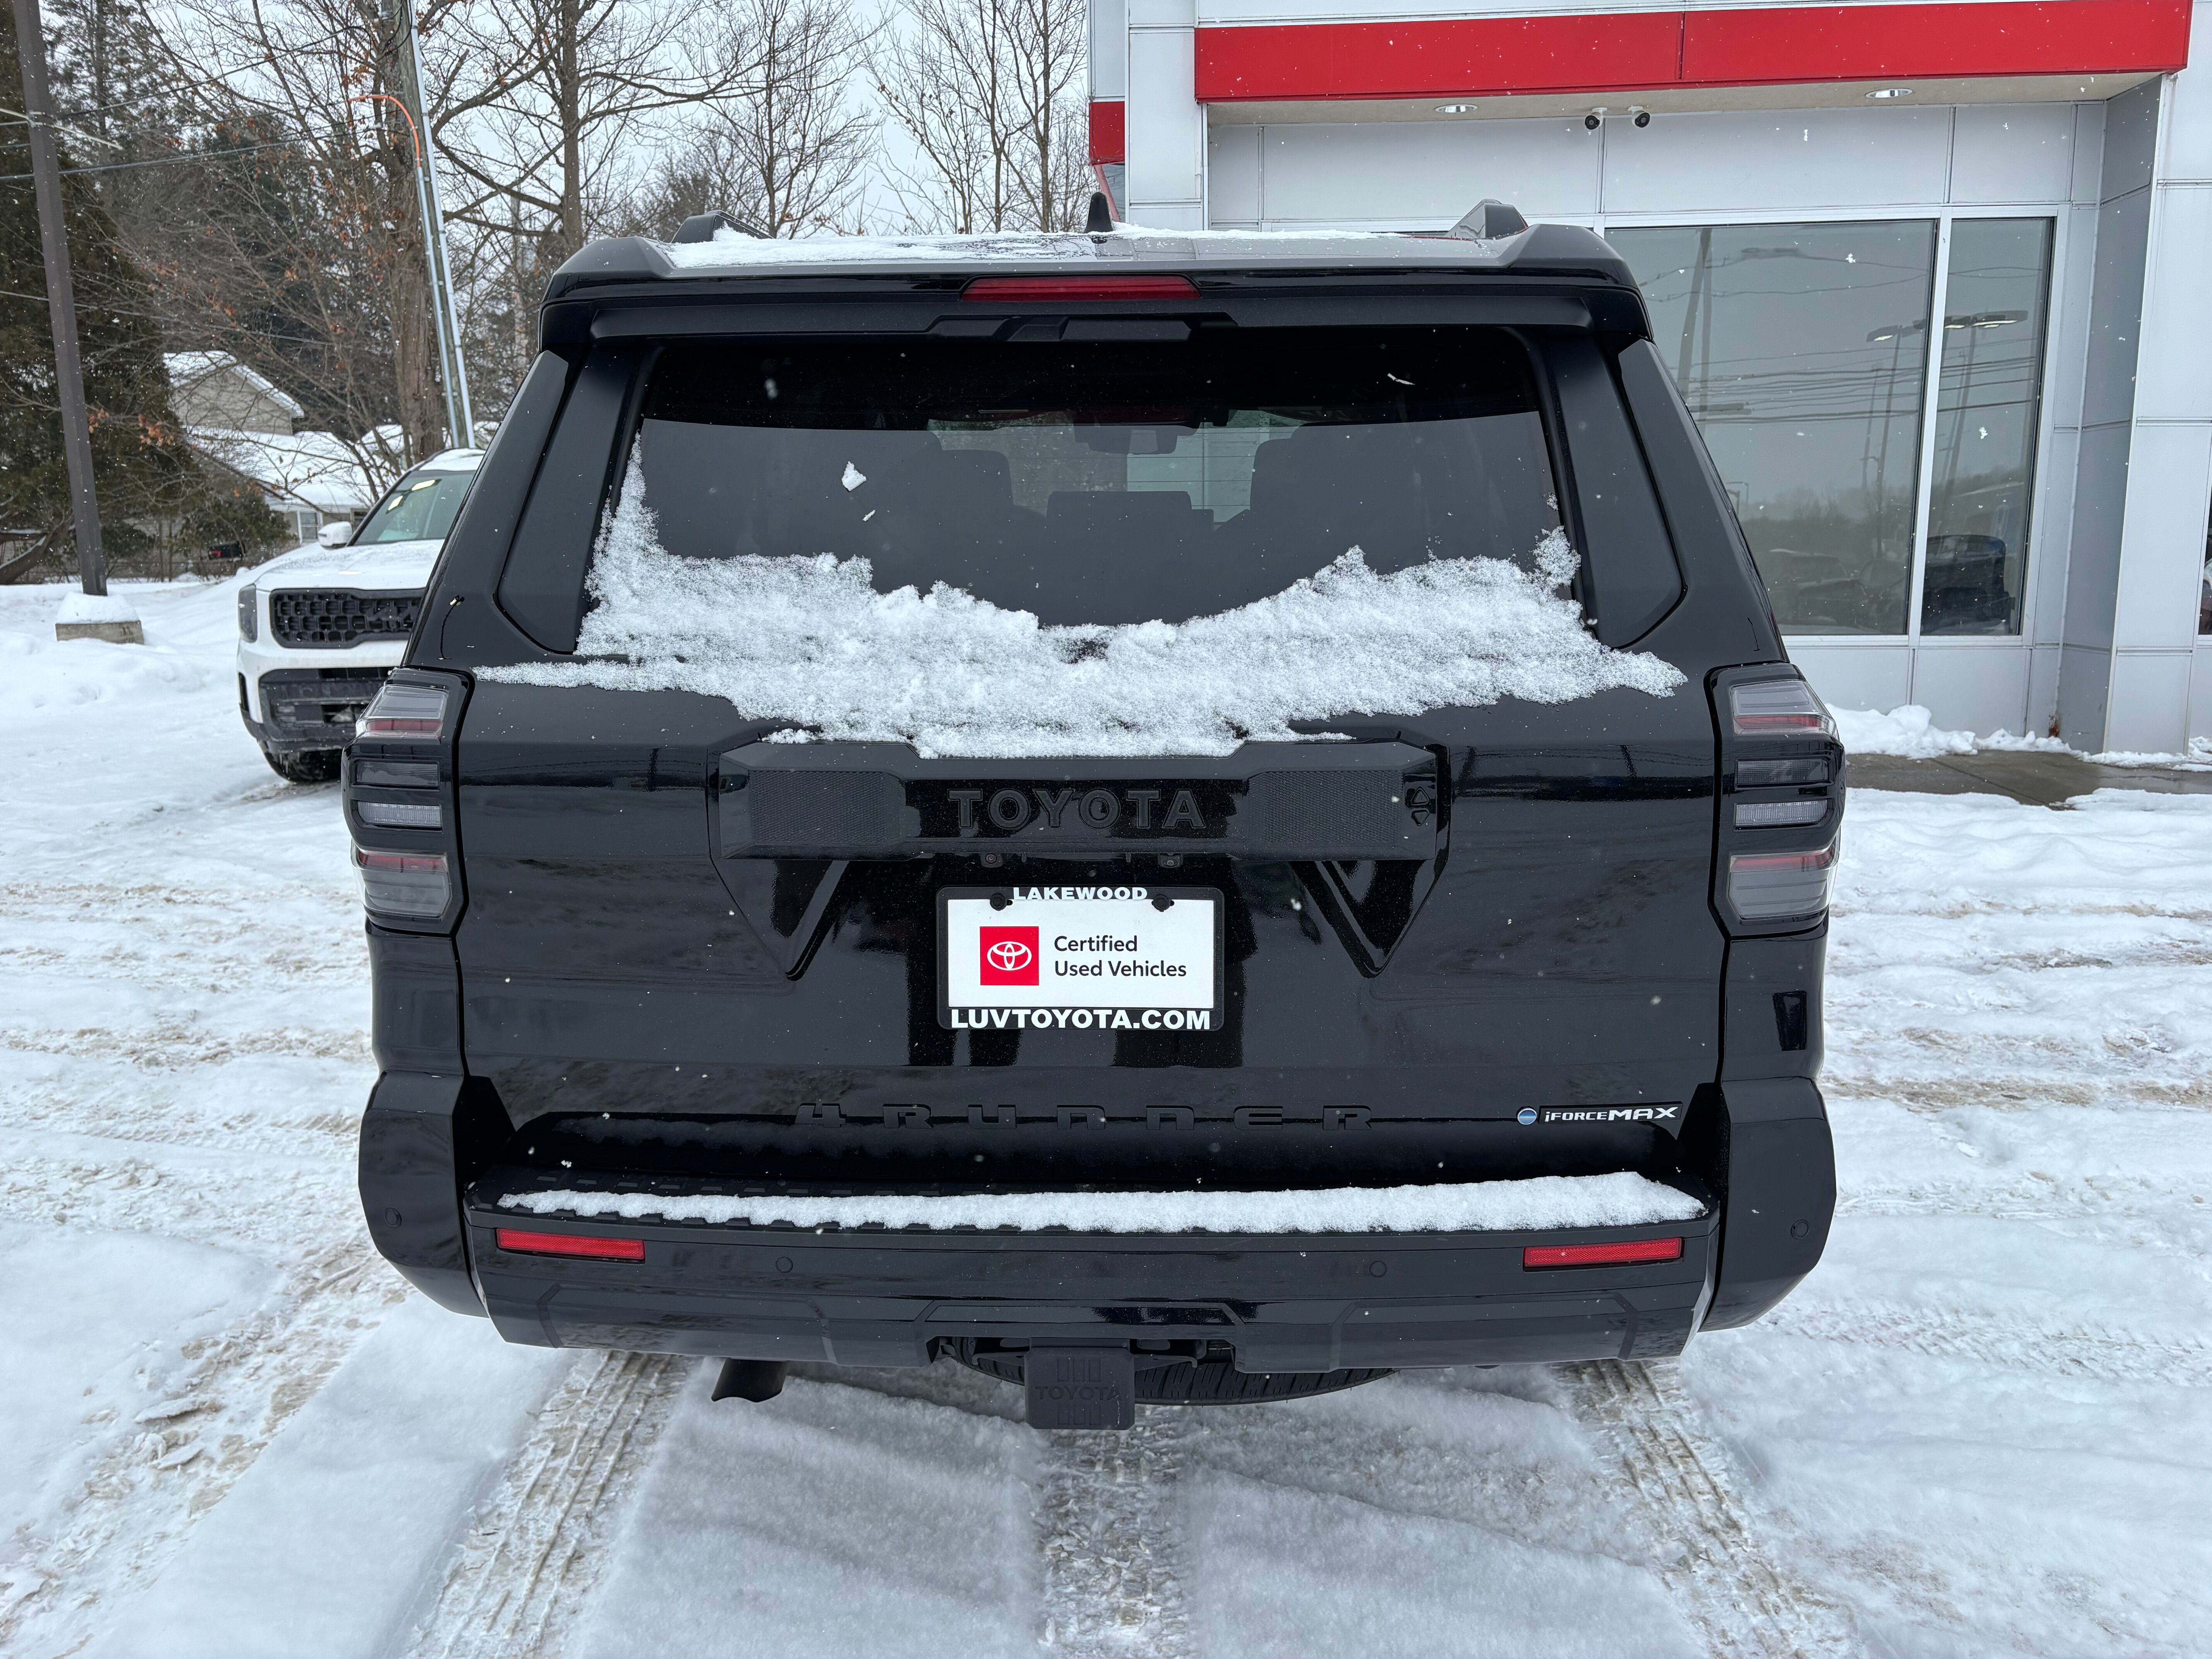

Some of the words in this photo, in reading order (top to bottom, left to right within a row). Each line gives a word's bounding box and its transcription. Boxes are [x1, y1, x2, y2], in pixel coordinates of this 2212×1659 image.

[947, 788, 1207, 829] TOYOTA
[1013, 886, 1148, 900] LAKEWOOD
[1054, 935, 1138, 952] Certified
[1054, 960, 1103, 976] Used
[1108, 960, 1187, 977] Vehicles
[951, 1009, 1211, 1030] LUVTOYOTA.COM
[795, 1103, 1373, 1130] 4RUNNER
[1036, 1385, 1122, 1400] TOYOTA
